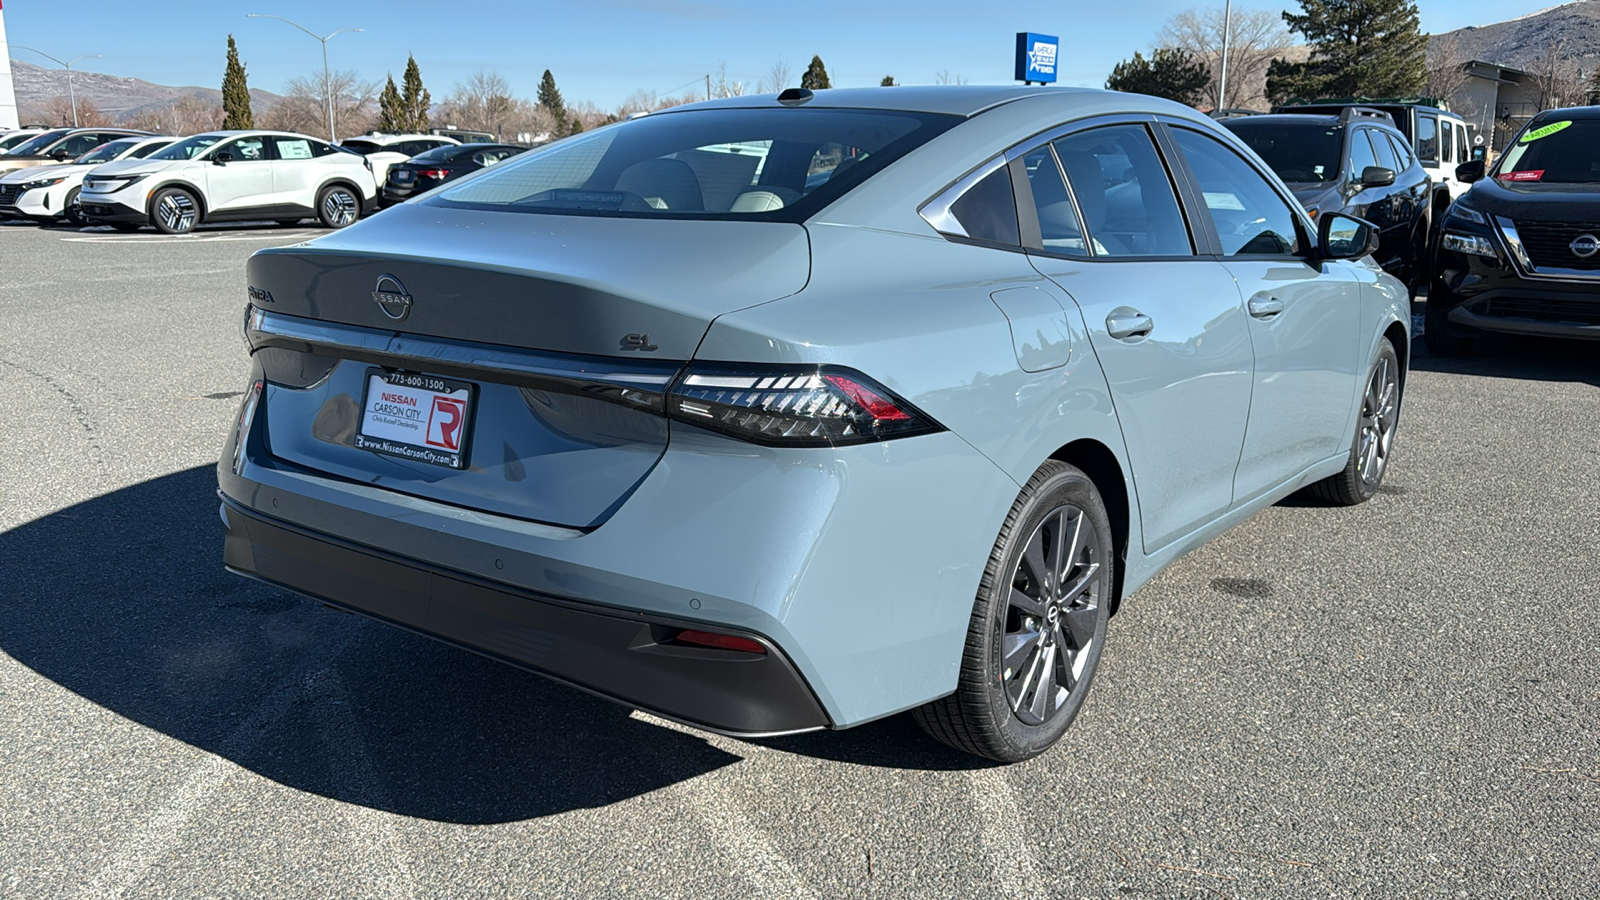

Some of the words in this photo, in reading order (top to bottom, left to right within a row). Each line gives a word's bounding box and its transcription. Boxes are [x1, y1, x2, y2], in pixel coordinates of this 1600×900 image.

[372, 291, 412, 307] NISSAN
[623, 333, 660, 350] SL
[391, 373, 444, 390] 775-600-1500
[381, 392, 417, 407] NISSAN
[374, 402, 405, 417] CARSON
[405, 408, 421, 420] CITY
[372, 415, 383, 423] Chris
[383, 417, 397, 426] Russell
[397, 419, 419, 431] Dealership
[436, 401, 461, 449] R
[364, 440, 450, 464] www.NissanCarsonCity.com
